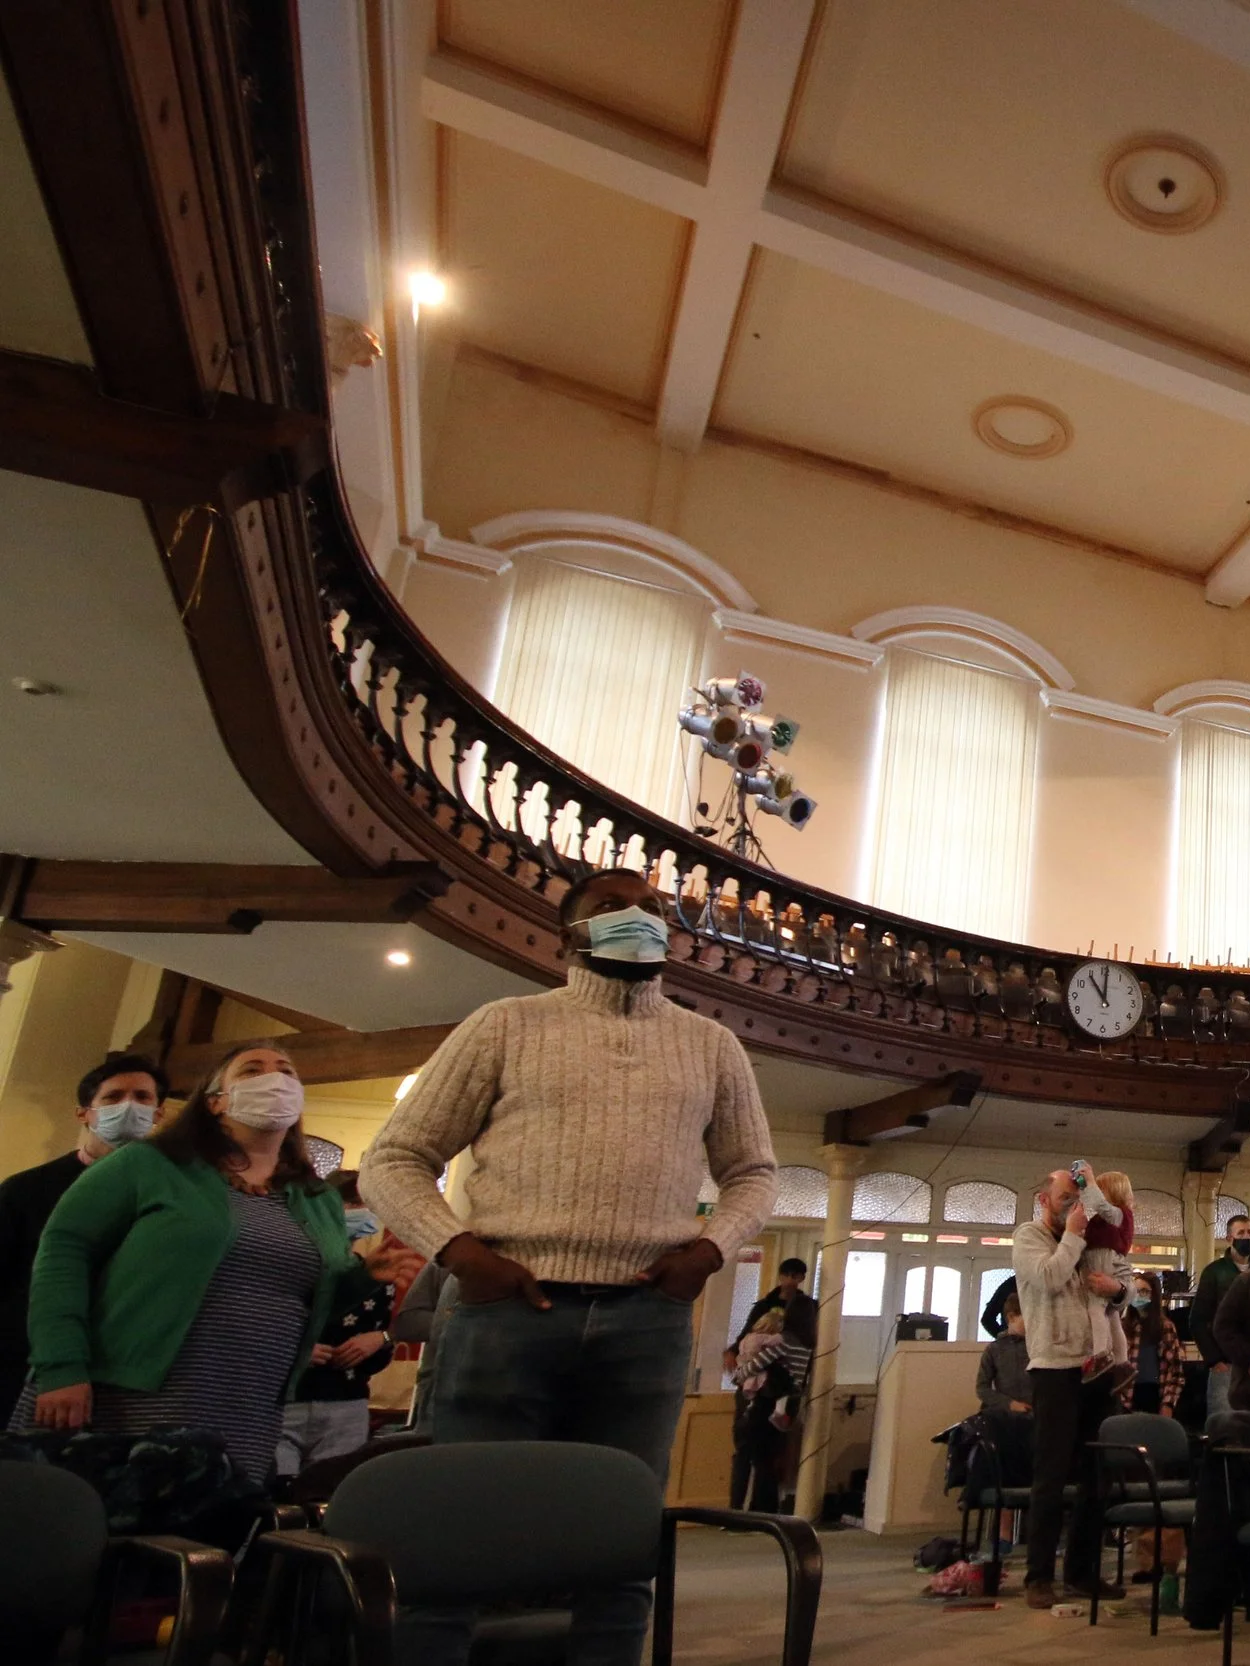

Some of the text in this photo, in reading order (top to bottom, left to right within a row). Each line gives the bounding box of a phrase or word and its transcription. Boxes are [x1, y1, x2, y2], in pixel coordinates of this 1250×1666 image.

[1077, 979, 1085, 988] 10
[1127, 986, 1133, 995] 2
[1072, 992, 1078, 1000] 9
[1130, 1000, 1136, 1008] 3
[1075, 1005, 1080, 1014] 8
[1126, 1013, 1132, 1021] 4
[1086, 1018, 1092, 1027] 7
[1115, 1022, 1120, 1030] 5
[1100, 1025, 1106, 1033] 6
